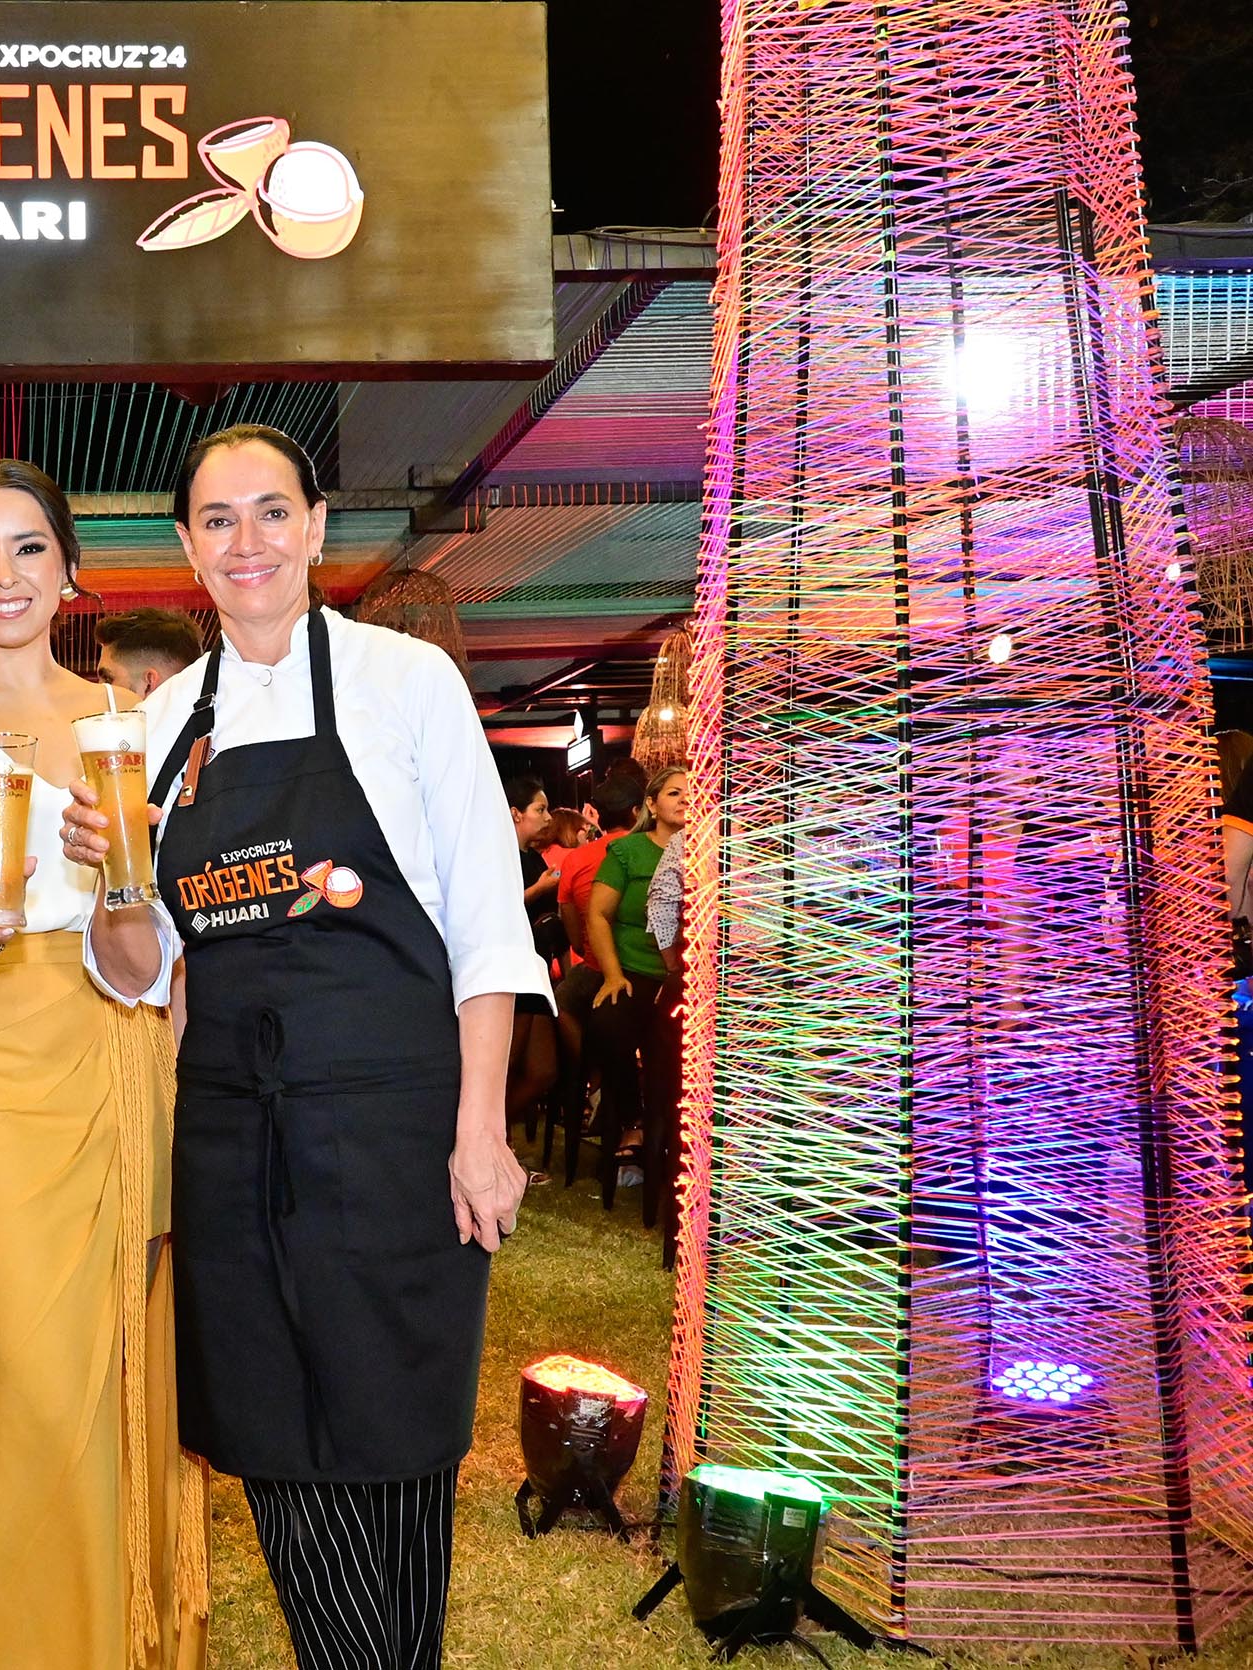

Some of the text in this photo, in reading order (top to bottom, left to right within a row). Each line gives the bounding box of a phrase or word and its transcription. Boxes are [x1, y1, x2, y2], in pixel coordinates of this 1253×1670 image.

[220, 838, 293, 864] EXPOCRUZ'24
[177, 854, 300, 911] ORÍGENES
[210, 902, 270, 928] HUARI
